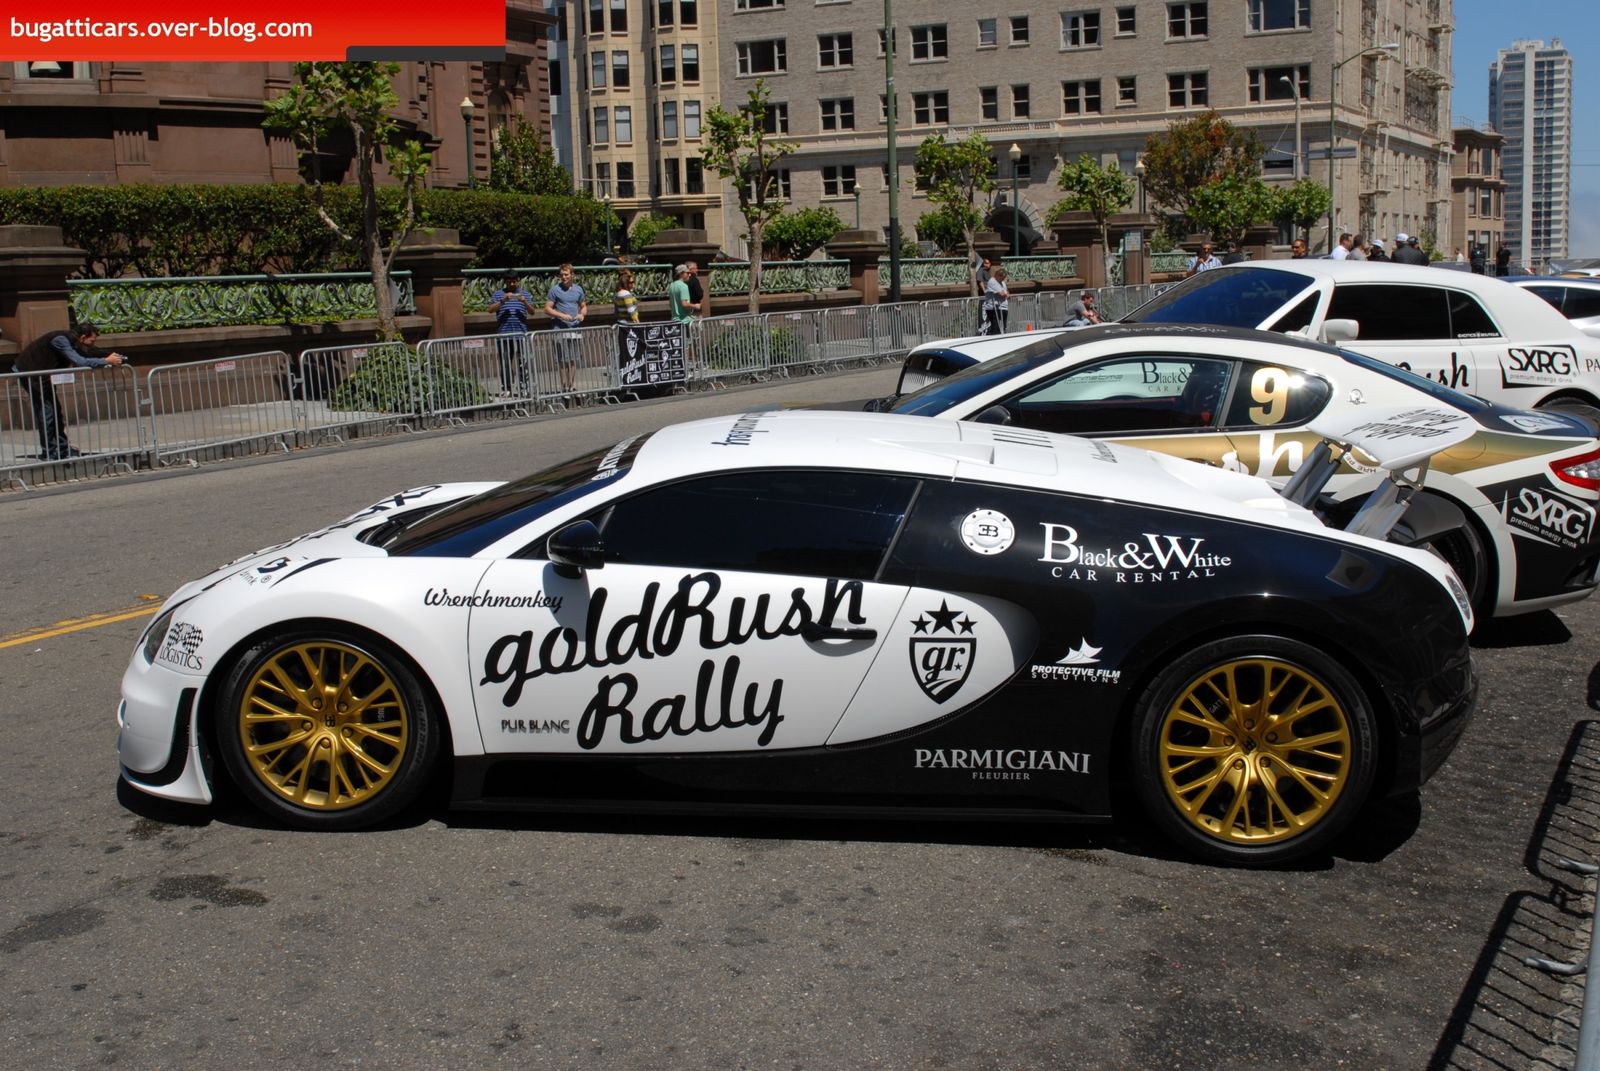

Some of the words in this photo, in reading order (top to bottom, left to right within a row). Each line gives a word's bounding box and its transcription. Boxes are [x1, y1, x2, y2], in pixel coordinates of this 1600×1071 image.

[1141, 360, 1191, 384] Black&
[1508, 348, 1571, 375] SXRG
[1249, 367, 1288, 425] 9
[1513, 487, 1587, 539] SXRG
[1510, 516, 1540, 531] premium
[1541, 529, 1561, 543] energy
[1038, 522, 1232, 570] Black&White
[1051, 566, 1098, 582] CAR
[1116, 568, 1216, 583] RENTAL
[424, 587, 563, 612] Wrenchmonkey
[479, 571, 867, 707] goldRush
[159, 646, 204, 671] LOGISTICS
[1031, 664, 1094, 677] PROTECTIVE
[1096, 668, 1121, 679] FILM
[1031, 672, 1119, 684] SOLUTIONS
[576, 655, 785, 750] Rally
[501, 719, 526, 733] PUR
[529, 719, 571, 733] BLANC
[914, 748, 1091, 774] PARMIGIANI
[972, 772, 1031, 780] FLEURIER
